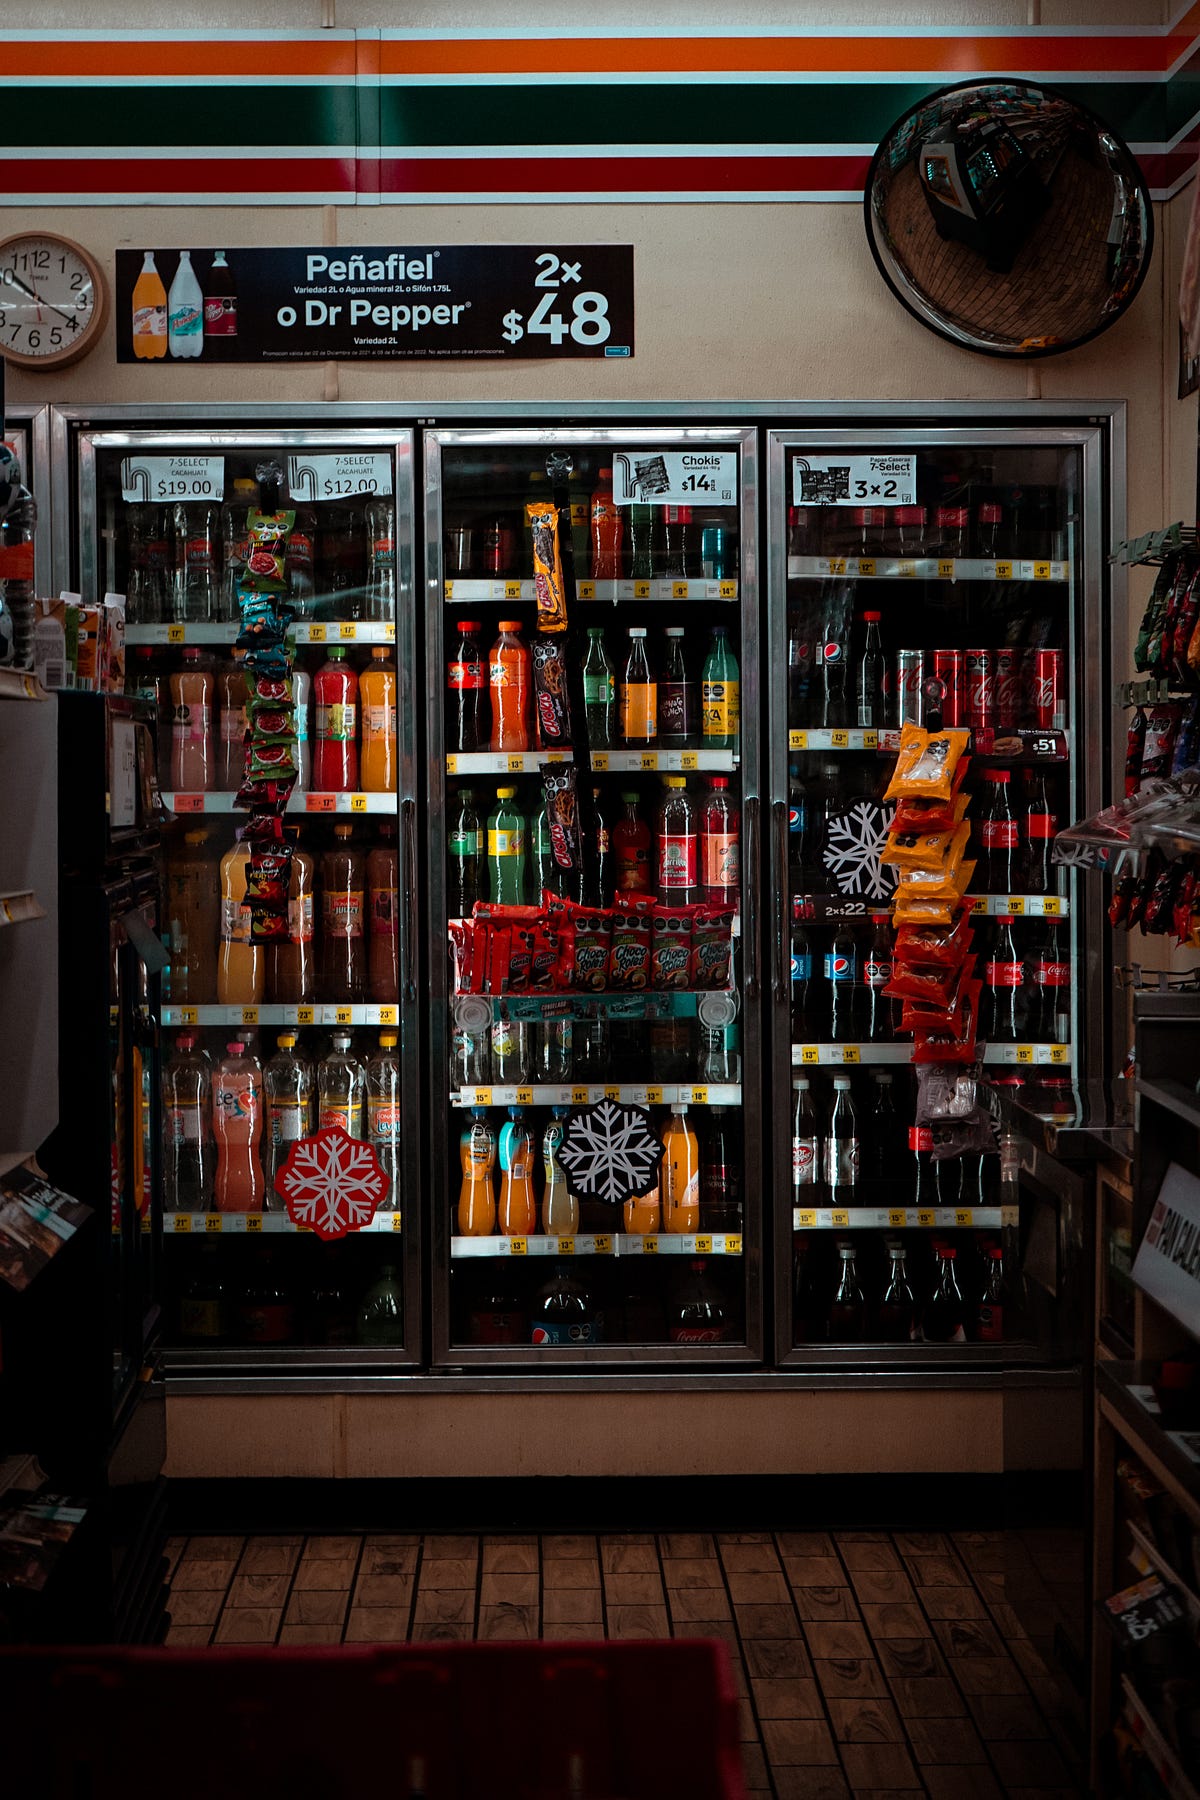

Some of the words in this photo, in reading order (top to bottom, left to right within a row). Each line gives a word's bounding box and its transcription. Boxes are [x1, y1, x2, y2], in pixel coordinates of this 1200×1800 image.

[11, 253, 27, 271] 11
[31, 250, 51, 269] 12
[58, 256, 66, 274] 1
[70, 272, 83, 290] 2
[293, 286, 328, 294] Variedad
[345, 286, 366, 295] Agua
[366, 285, 394, 293] mineral
[394, 285, 405, 293] 2L
[411, 284, 432, 293] Sifón
[432, 284, 452, 292] 1.75L
[76, 293, 88, 311] 3
[276, 305, 298, 327] o
[305, 300, 342, 326] Dr
[501, 291, 612, 346] $48
[66, 315, 80, 333] 4
[10, 324, 22, 342] 7
[28, 330, 41, 348] 6
[50, 327, 62, 345] 5
[353, 337, 387, 345] Variedad
[388, 336, 398, 344] 2L
[168, 458, 210, 467] 7-SELECT
[335, 456, 376, 467] 7-SELECT
[682, 455, 721, 465] Chokis
[870, 463, 911, 471] 7-Select
[337, 468, 374, 476] CACAHUATE
[157, 479, 212, 496] $19.00
[324, 478, 378, 496] $12.00
[681, 474, 710, 491] $14
[1032, 738, 1057, 751] $51
[576, 947, 608, 962] Choco
[615, 945, 647, 960] Choco
[658, 948, 689, 963] Choco
[580, 957, 605, 973] Roles
[618, 956, 644, 972] Roles
[661, 958, 687, 974] Roles
